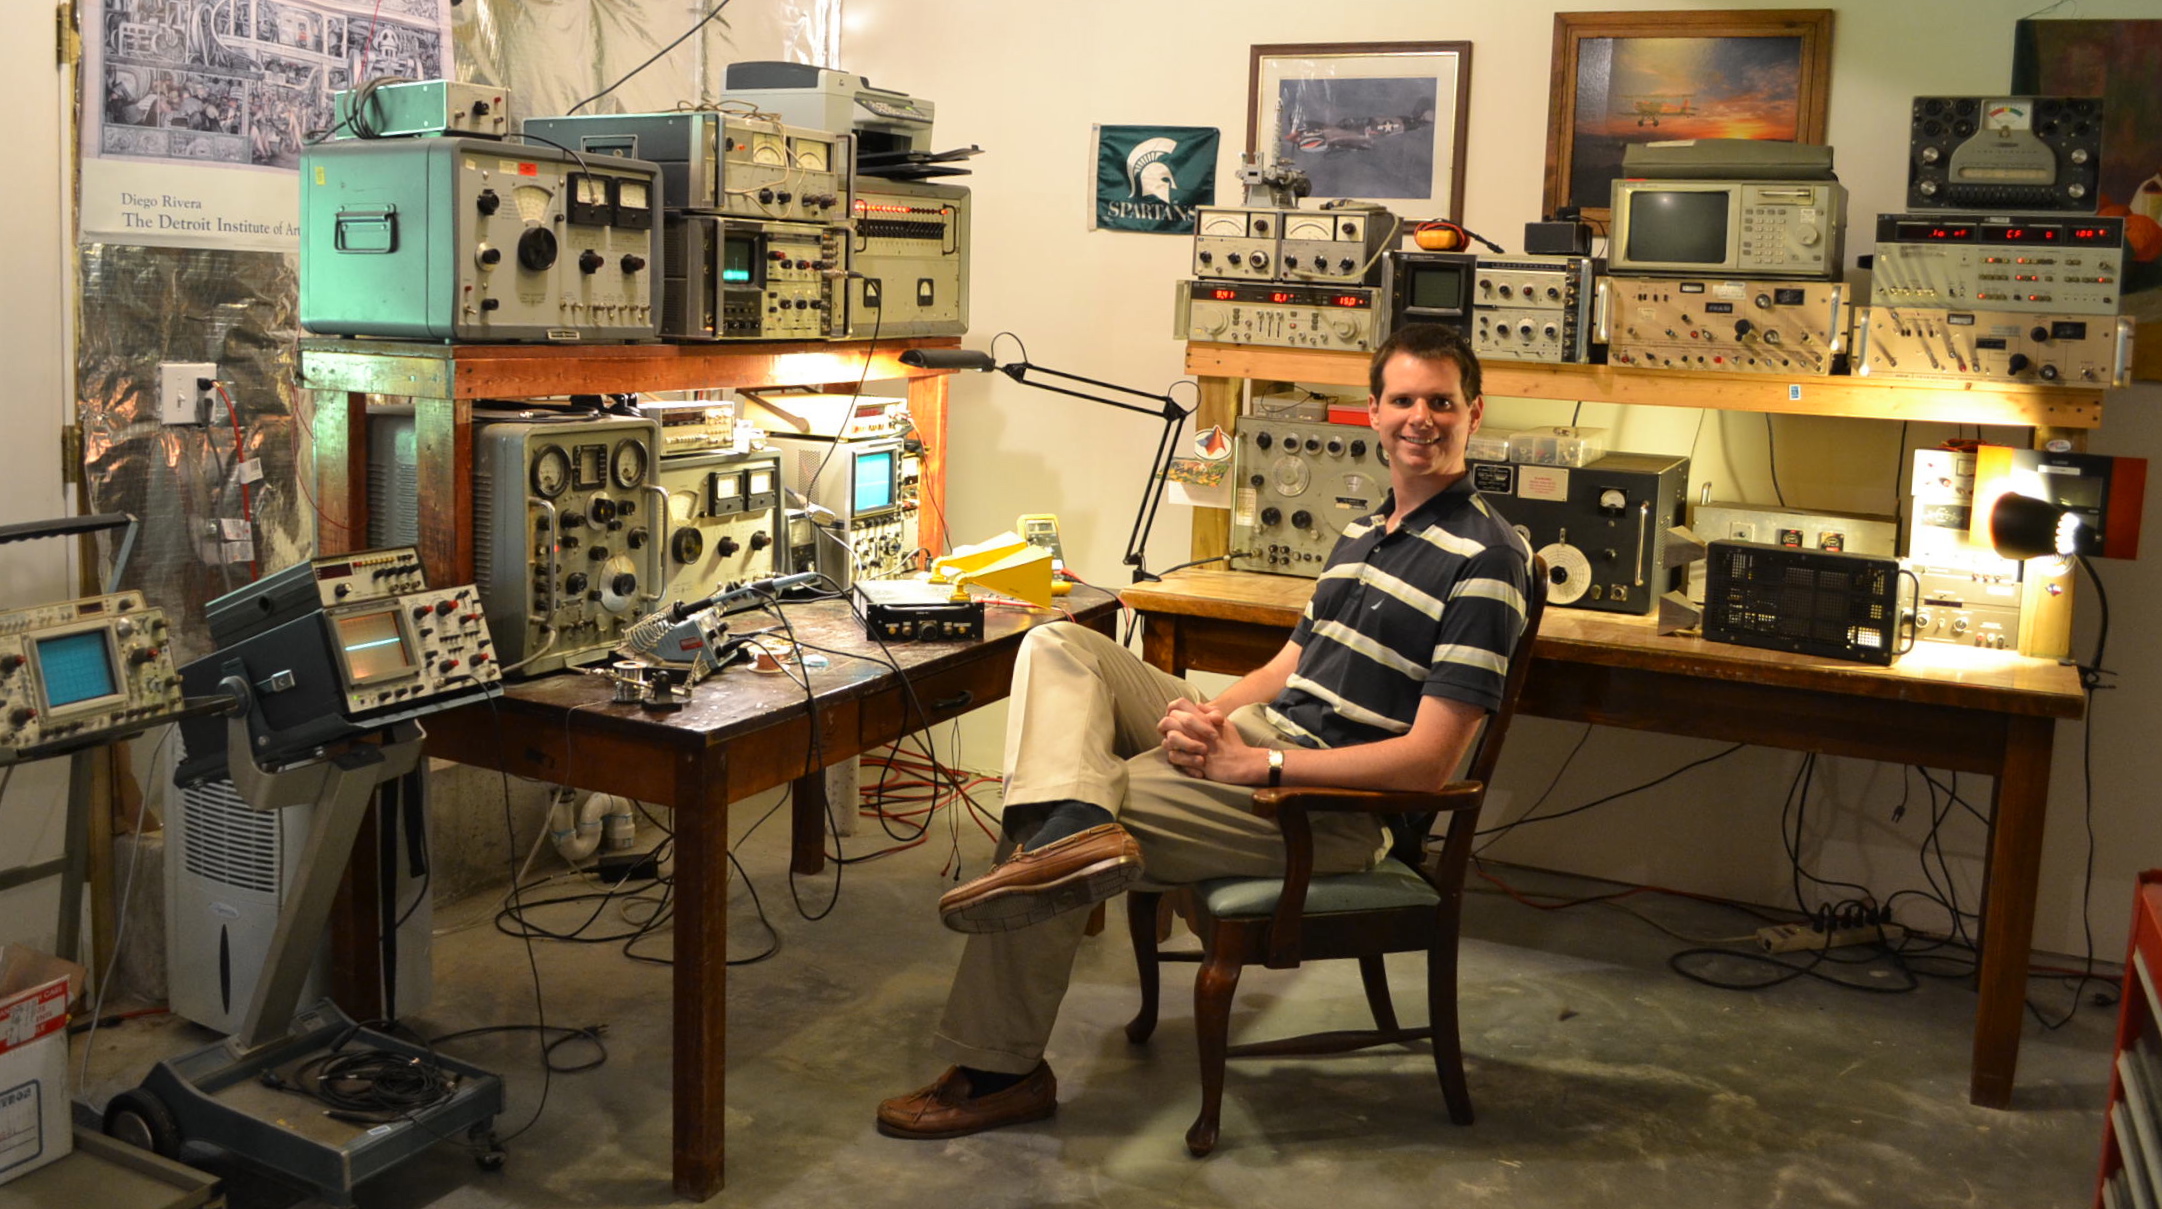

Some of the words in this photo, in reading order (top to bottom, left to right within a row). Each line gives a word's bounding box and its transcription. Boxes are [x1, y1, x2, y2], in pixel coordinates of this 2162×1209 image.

[121, 192, 158, 209] Diego
[162, 194, 202, 210] Rivera
[1107, 200, 1196, 222] SPARTANS
[122, 212, 153, 228] The
[159, 214, 211, 231] Detroit
[217, 217, 270, 235] Institute
[273, 221, 283, 235] of
